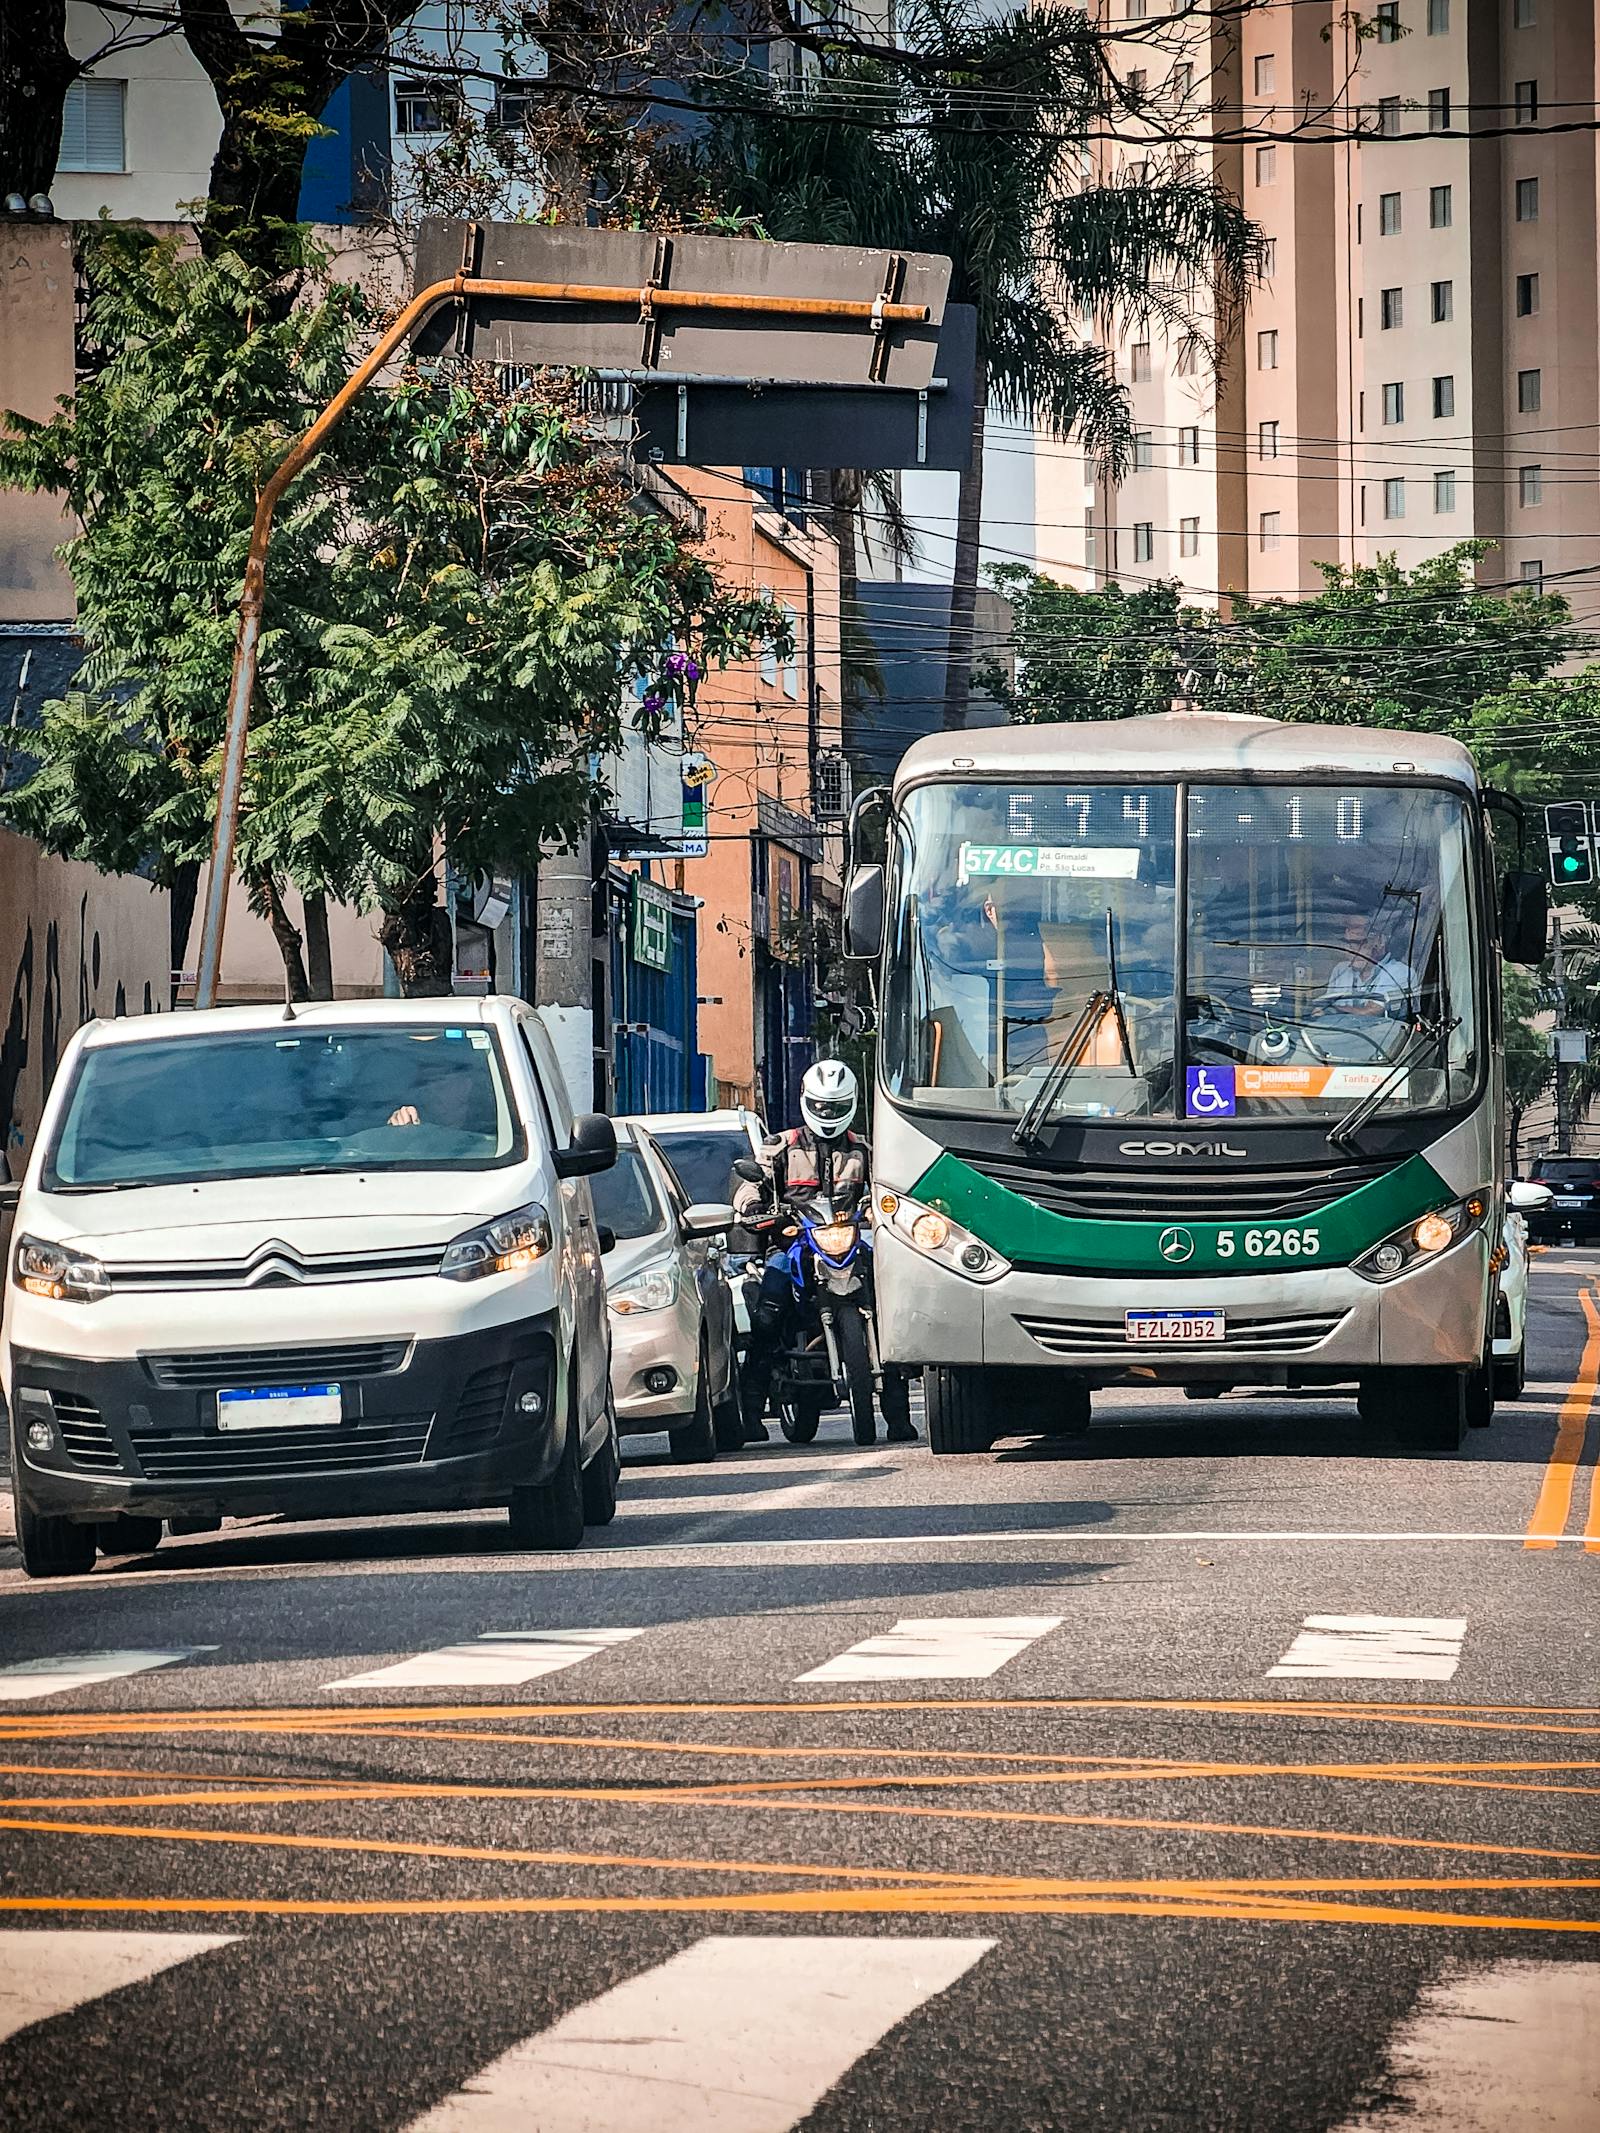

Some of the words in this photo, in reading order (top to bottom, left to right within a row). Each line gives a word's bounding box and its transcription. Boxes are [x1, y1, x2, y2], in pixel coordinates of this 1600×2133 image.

[965, 849, 1033, 873] 574C
[1055, 852, 1088, 861] Grimaldi
[1072, 864, 1095, 872] Lucas
[1262, 1068, 1310, 1082] DOMINGÃO
[1343, 1074, 1369, 1083] Tarifa
[1372, 1075, 1393, 1084] Zeo
[1118, 1141, 1247, 1157] COMIL
[1216, 1230, 1235, 1258] 5
[1244, 1228, 1320, 1256] 6265
[1137, 1321, 1215, 1338] EZL2D52
